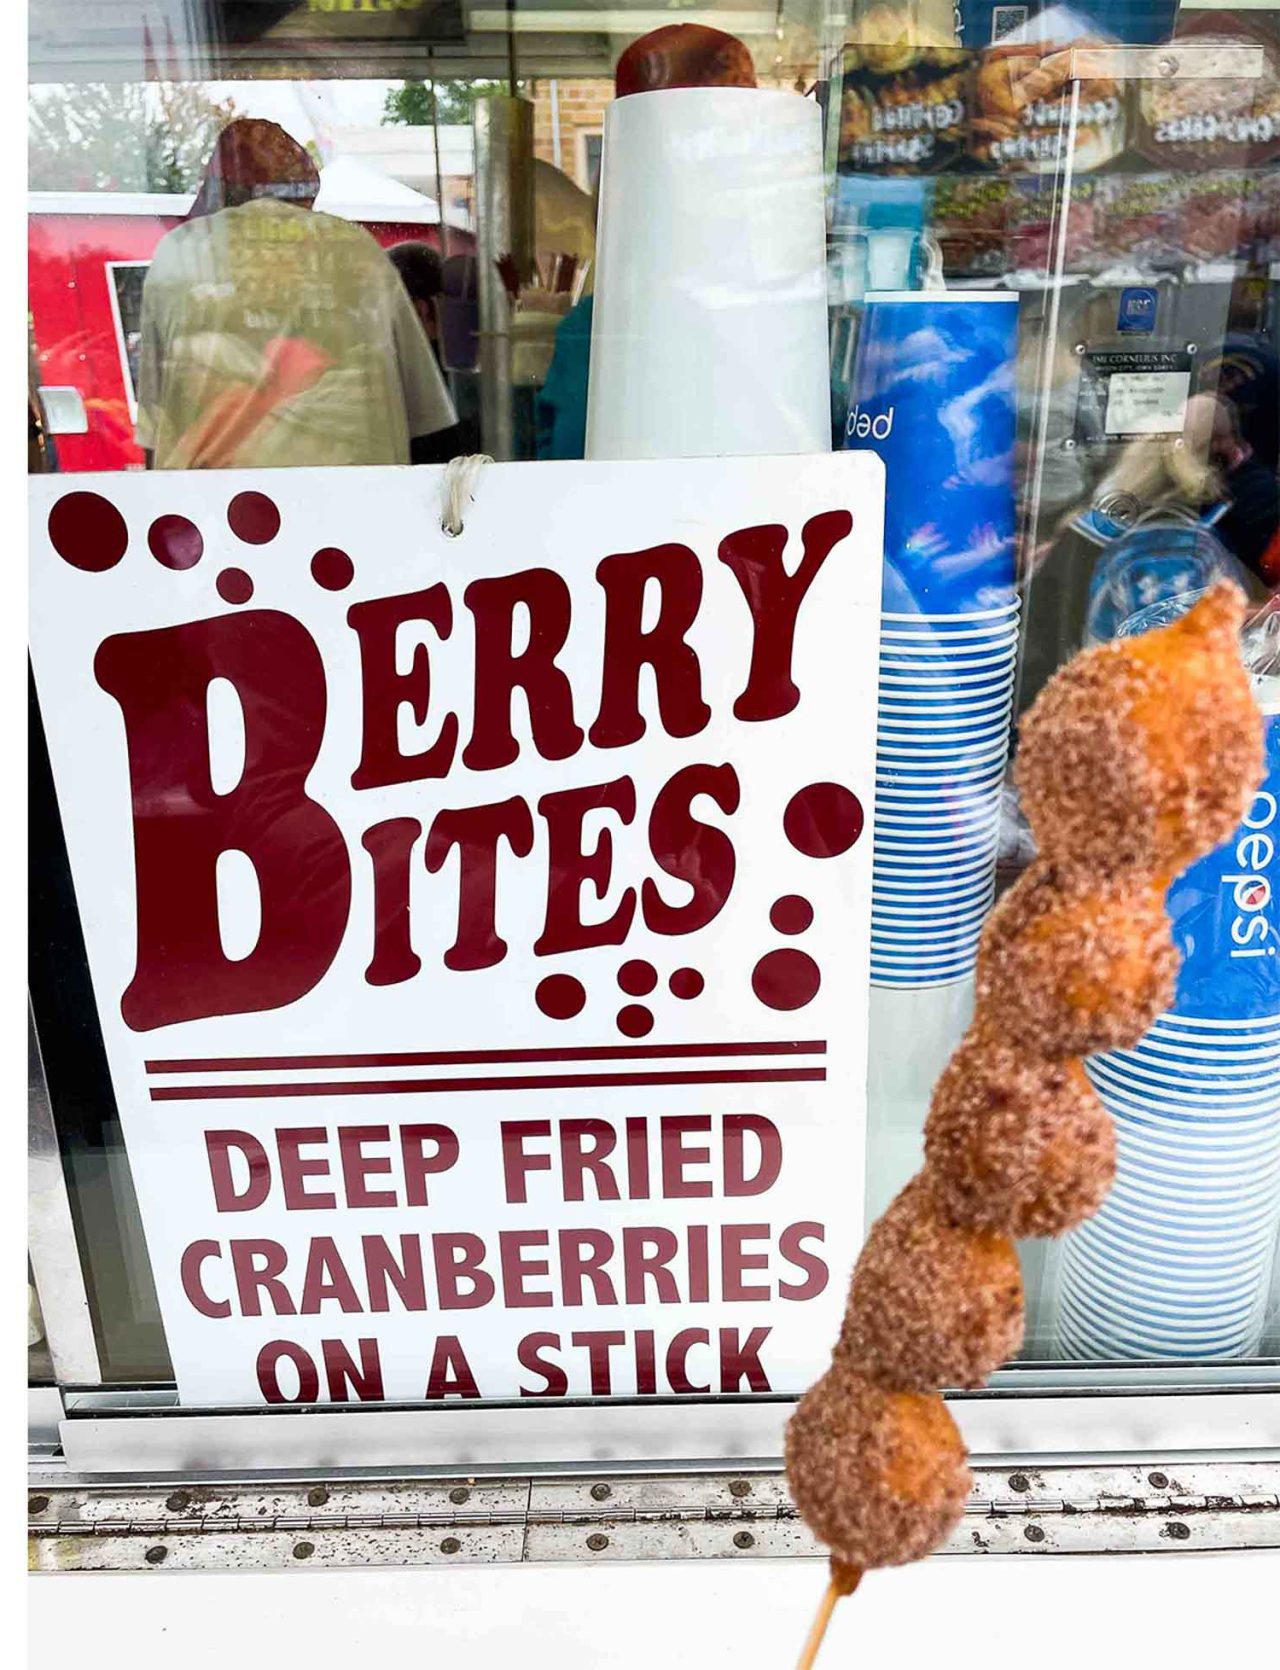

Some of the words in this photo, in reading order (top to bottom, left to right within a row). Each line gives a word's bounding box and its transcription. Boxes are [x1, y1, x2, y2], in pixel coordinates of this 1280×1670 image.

[847, 404, 894, 440] pep
[94, 509, 854, 1032] BERRY
[204, 1123, 460, 1212] DEEP
[500, 1113, 783, 1204] FRIED
[180, 1221, 830, 1319] CRANBERRIES
[256, 1338, 385, 1404] ON
[425, 1335, 482, 1399] A
[517, 1326, 774, 1397] STICK
